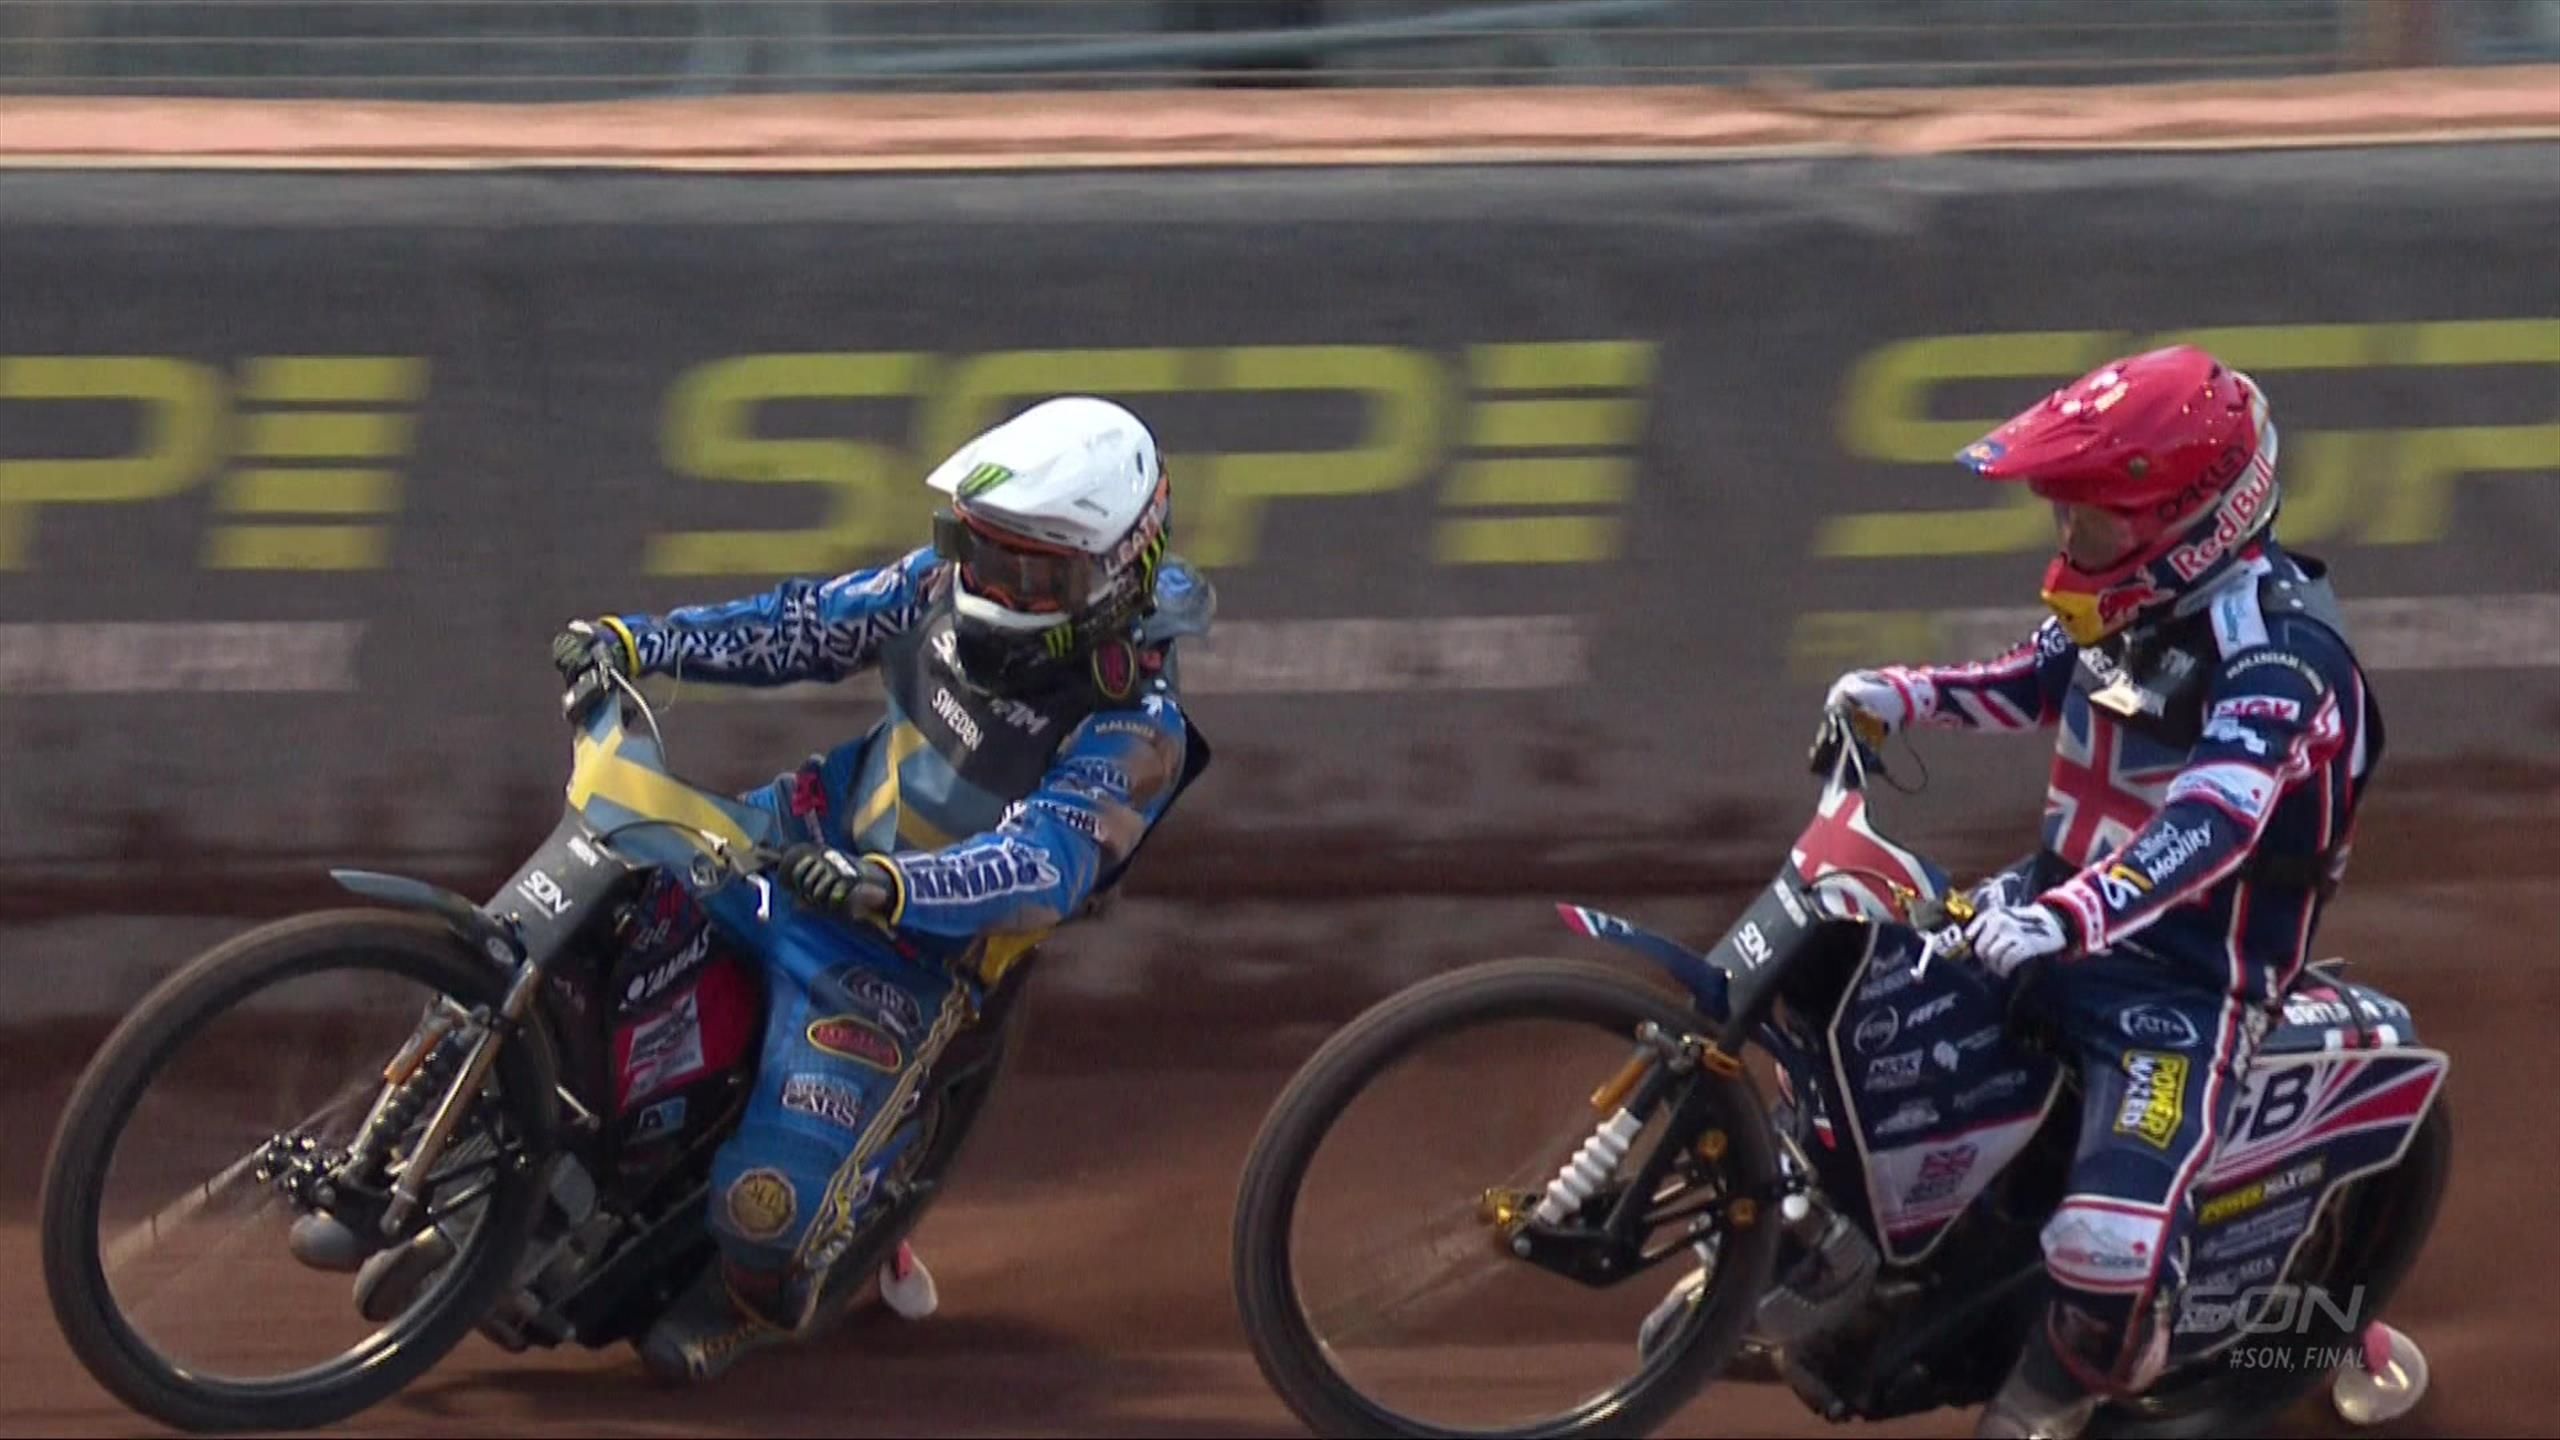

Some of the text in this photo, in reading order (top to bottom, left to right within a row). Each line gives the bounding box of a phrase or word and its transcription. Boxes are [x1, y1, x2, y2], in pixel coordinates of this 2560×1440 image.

[2166, 449, 2273, 583] Red Bull
[930, 686, 984, 751] SWEDEN
[2146, 818, 2213, 886] Mobility
[2121, 1053, 2152, 1128] MAXED
[2148, 1057, 2180, 1137] POWER
